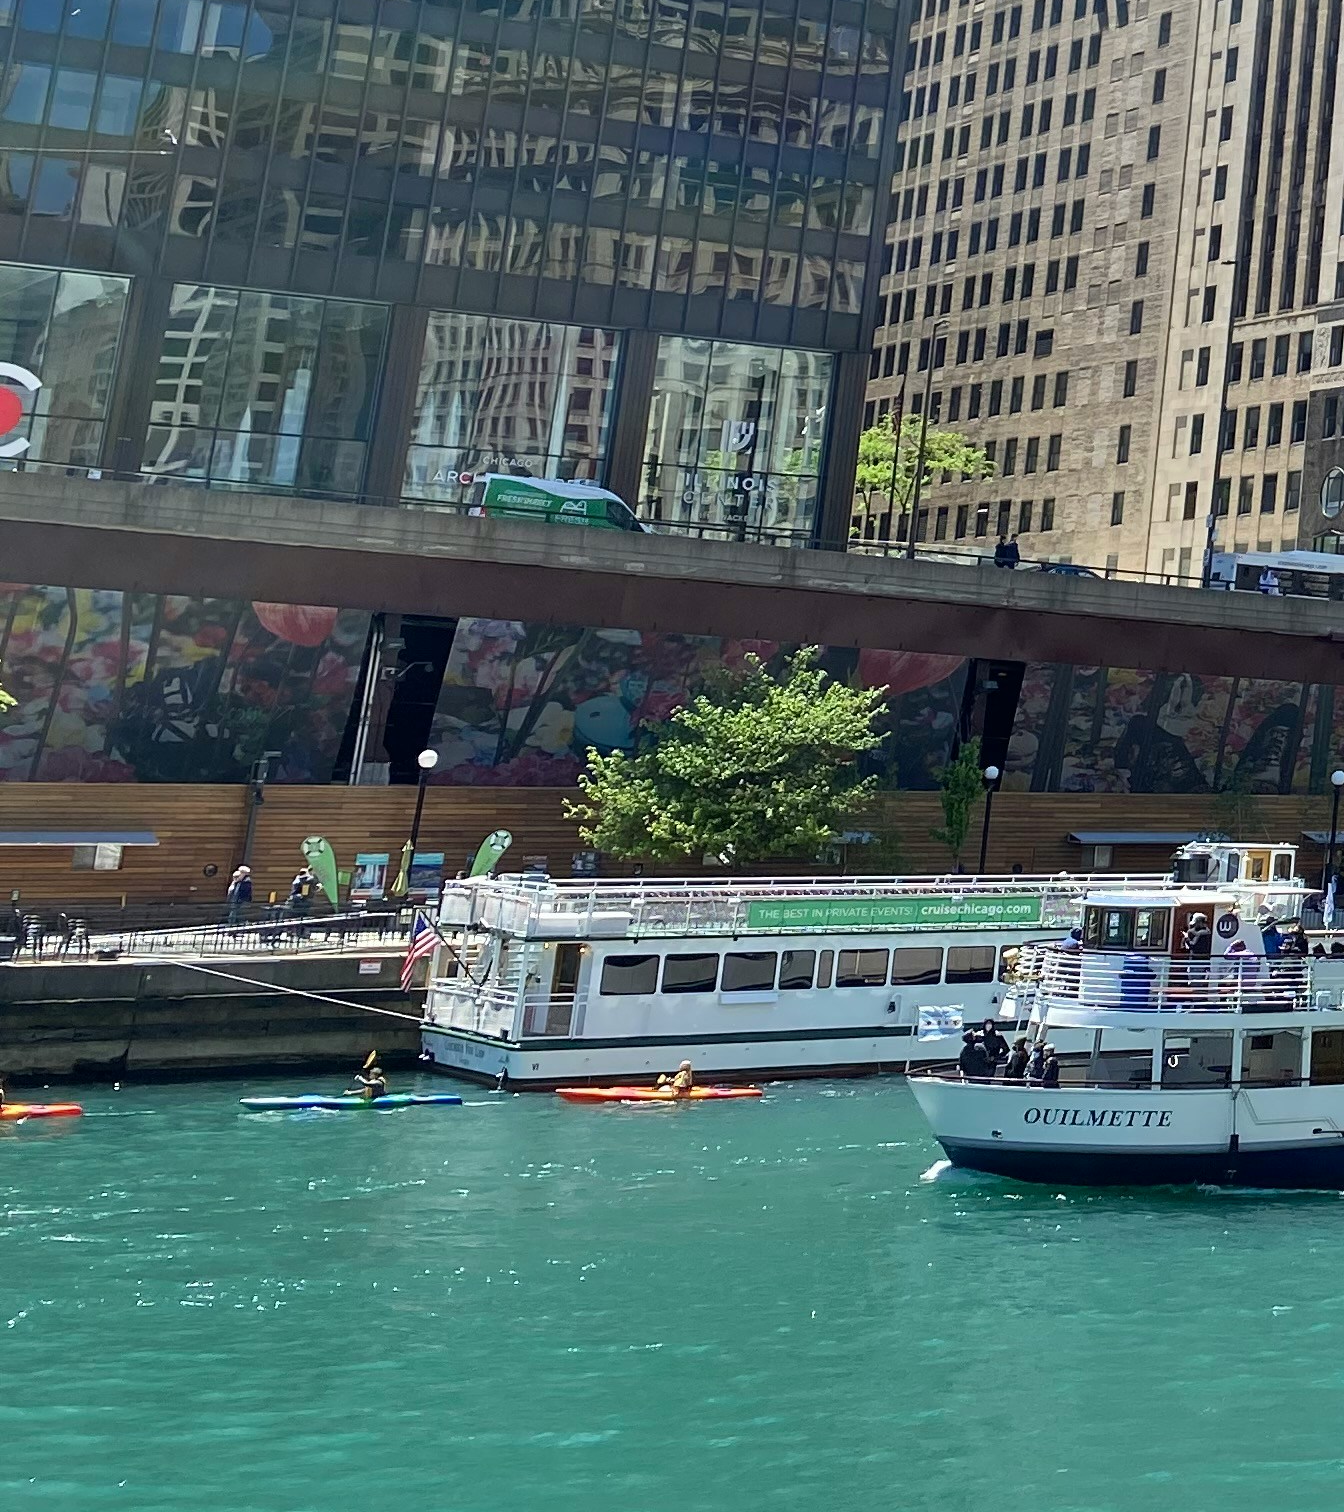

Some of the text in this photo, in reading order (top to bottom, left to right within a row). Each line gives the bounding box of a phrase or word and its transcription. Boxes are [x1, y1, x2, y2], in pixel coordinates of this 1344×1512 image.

[482, 456, 533, 468] CHICAGO
[759, 903, 1032, 919] THE BEST IN PRIVATE EVENTS! cruisechicago.com
[1024, 1107, 1174, 1127] OUILMETTE
